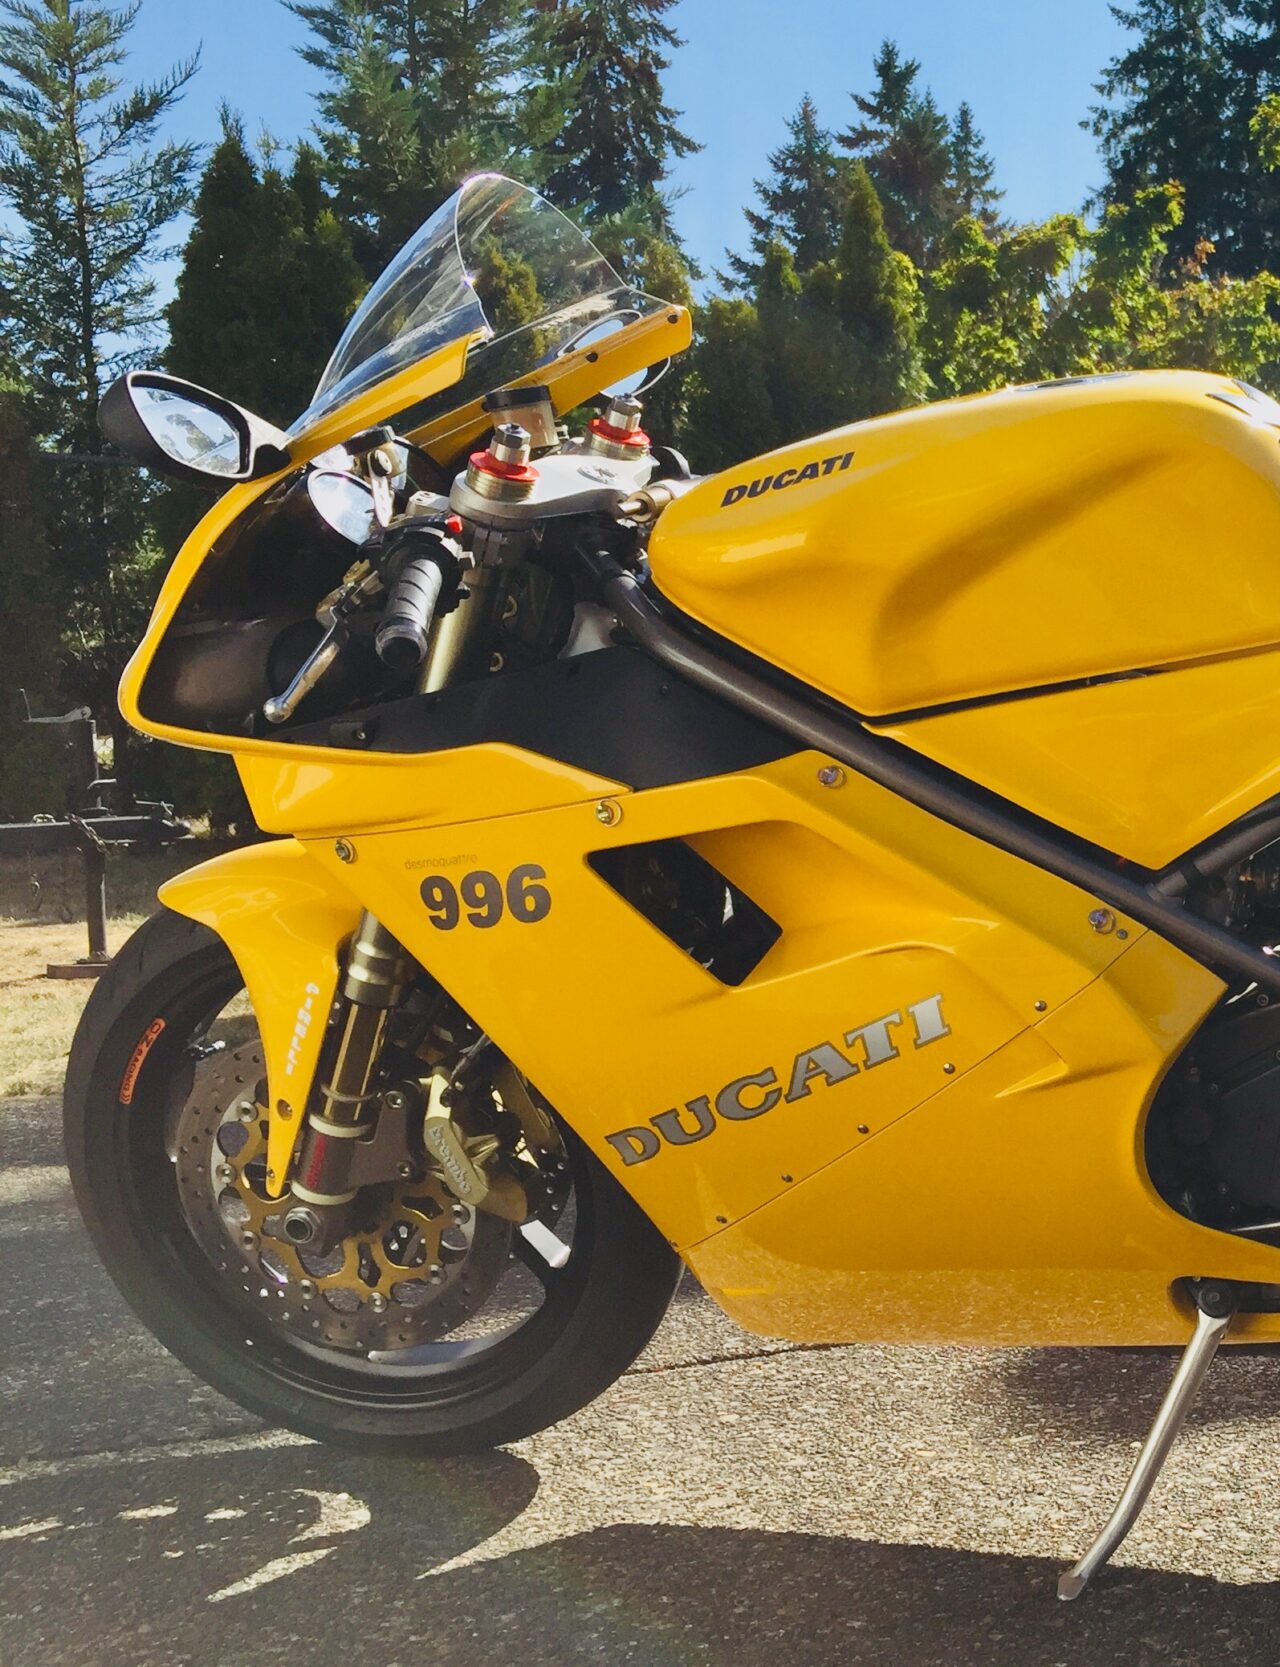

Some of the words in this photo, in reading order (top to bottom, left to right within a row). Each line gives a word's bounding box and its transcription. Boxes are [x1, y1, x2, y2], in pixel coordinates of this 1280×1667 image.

[720, 452, 855, 507] DUCATI
[404, 854, 478, 870] desmoquattro
[420, 864, 552, 931] 996
[604, 992, 952, 1167] DUCATI
